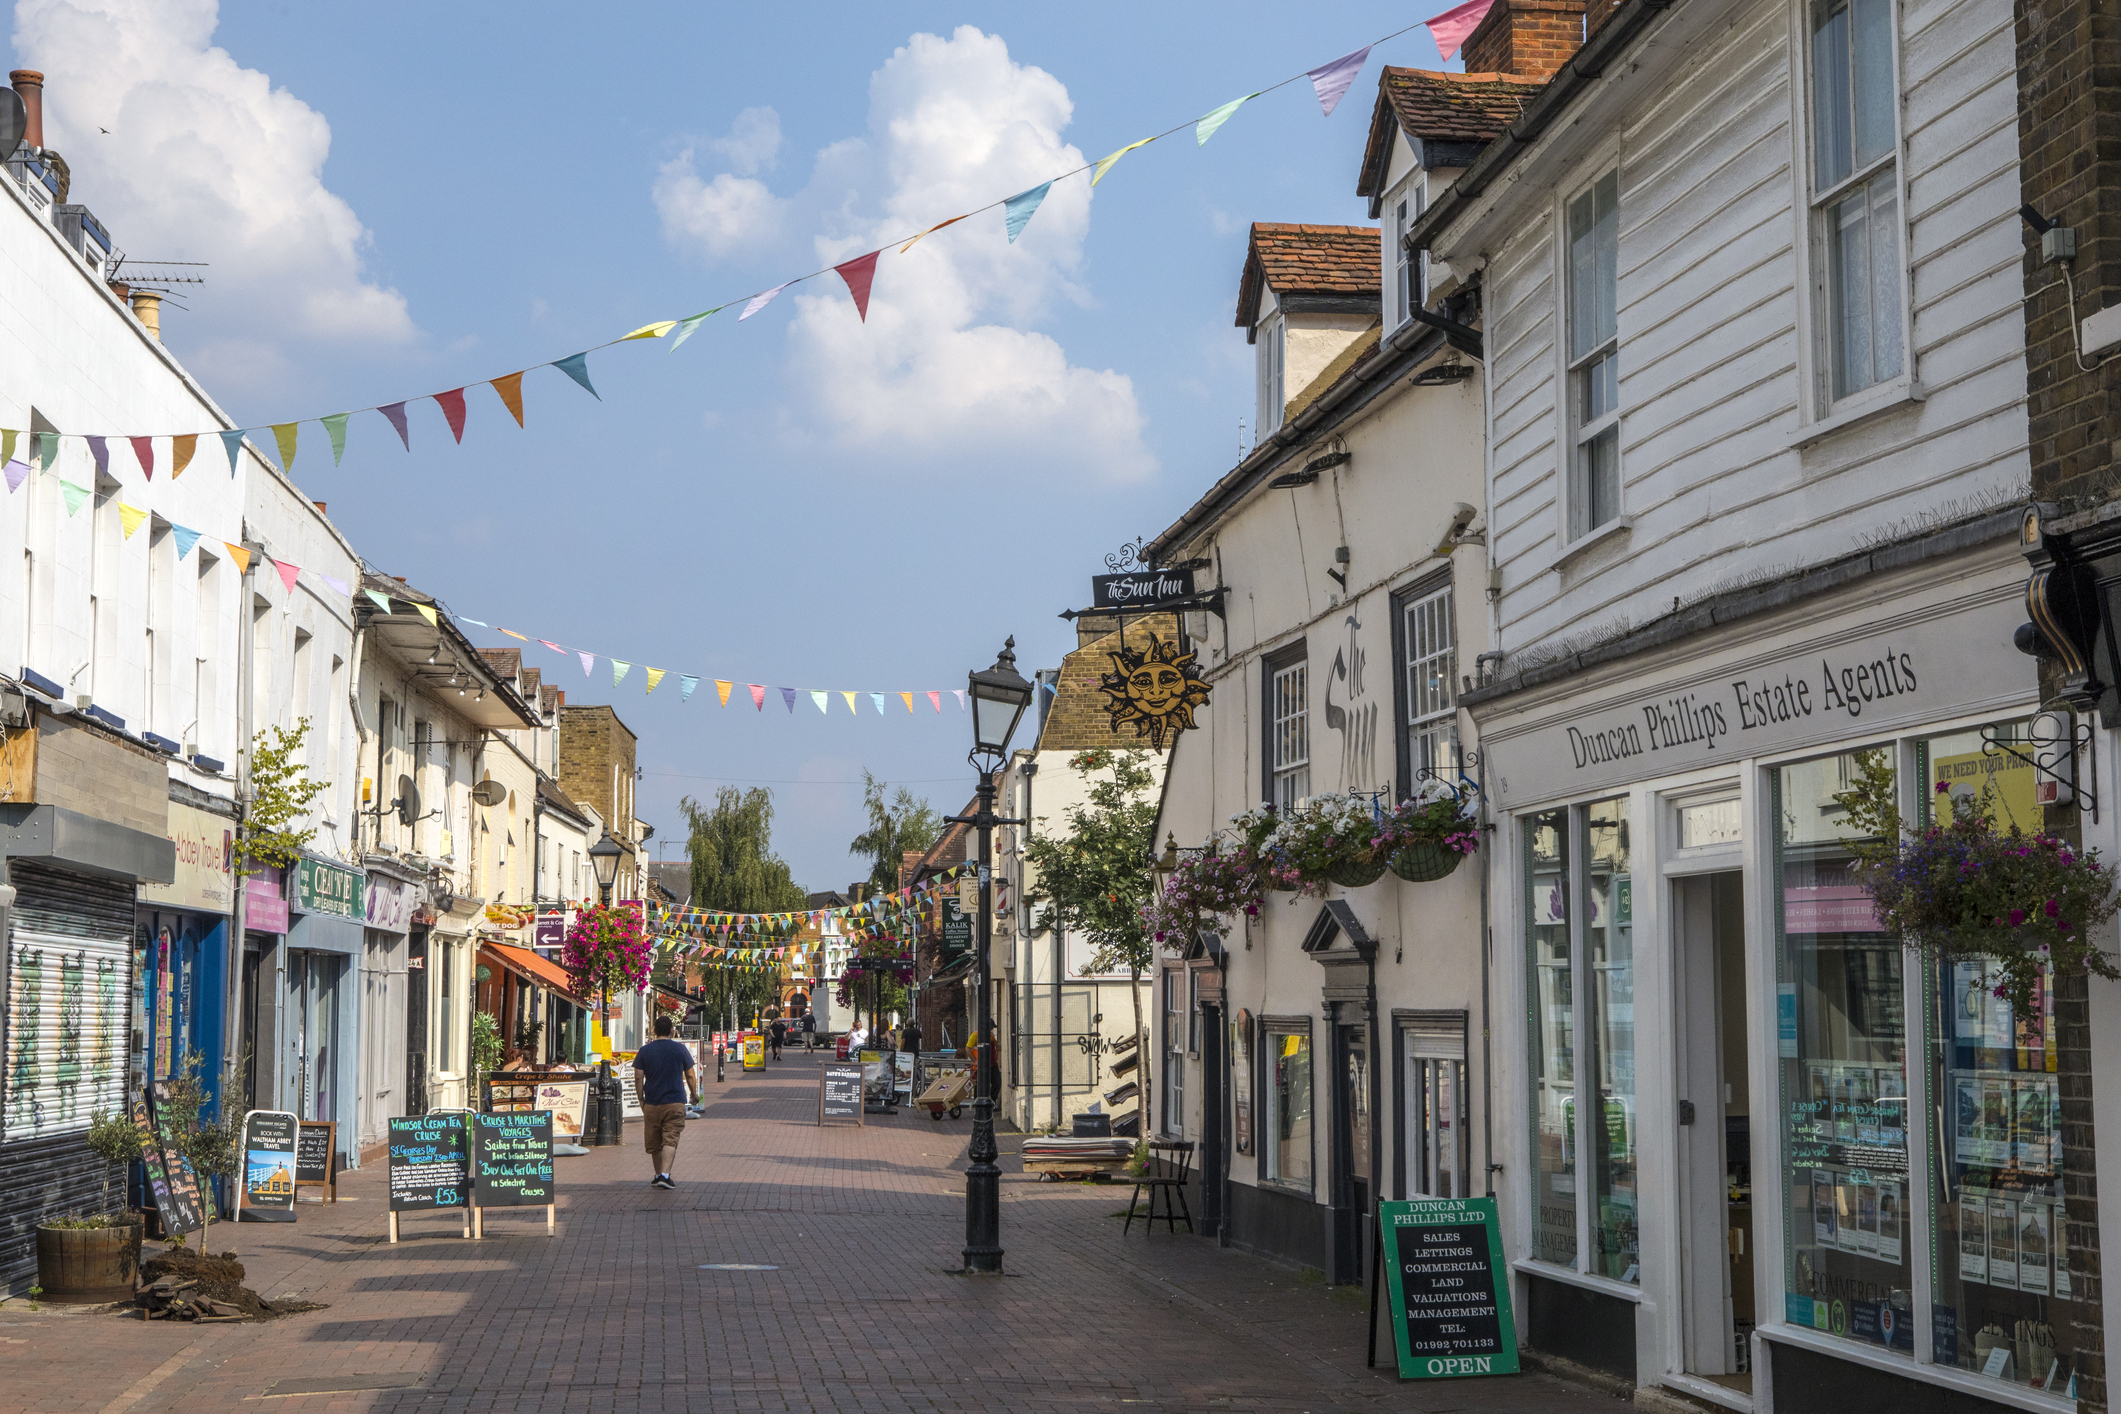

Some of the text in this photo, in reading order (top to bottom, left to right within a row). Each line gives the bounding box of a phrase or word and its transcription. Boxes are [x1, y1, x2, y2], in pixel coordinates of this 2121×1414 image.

[1117, 574, 1154, 601] Sun
[1153, 574, 1184, 600] Inn
[1566, 646, 1917, 769] Duncan Phillips Estate Agents
[1937, 764, 1952, 780] WE
[1953, 760, 1978, 778] NEED
[1979, 755, 2005, 774] YOUR
[175, 830, 200, 873] Abbey
[201, 837, 222, 870] Travel
[542, 1098, 580, 1107] Nail Care
[390, 1115, 462, 1131] WINDSOR CREAM TEA
[481, 1114, 506, 1126] CRUISE
[514, 1115, 547, 1125] MARITIME
[414, 1131, 442, 1141] CRUISE
[499, 1127, 532, 1136] VOYAGES
[448, 1152, 466, 1160] APRIL
[538, 1160, 553, 1175] FREE
[435, 1187, 457, 1205] £55
[1408, 1201, 1466, 1212] DUNCAN
[1394, 1211, 1485, 1224] PHILLIPS LTD
[1540, 1206, 1576, 1229] PROPERTY
[1423, 1233, 1461, 1242] SALES
[1415, 1247, 1473, 1258] LETTINGS
[1405, 1262, 1487, 1273] COMMERCIAL
[1431, 1278, 1464, 1288] LAND
[1812, 1271, 1891, 1309] COMMERCIAL
[1412, 1292, 1487, 1303] VALUATIONS
[1408, 1307, 1495, 1318] MANAGEMENT
[1439, 1324, 1466, 1333] TEL:
[1981, 1308, 2058, 1349] LETTINGS
[1416, 1339, 1494, 1349] 01992 701133
[1427, 1356, 1492, 1375] OPEN
